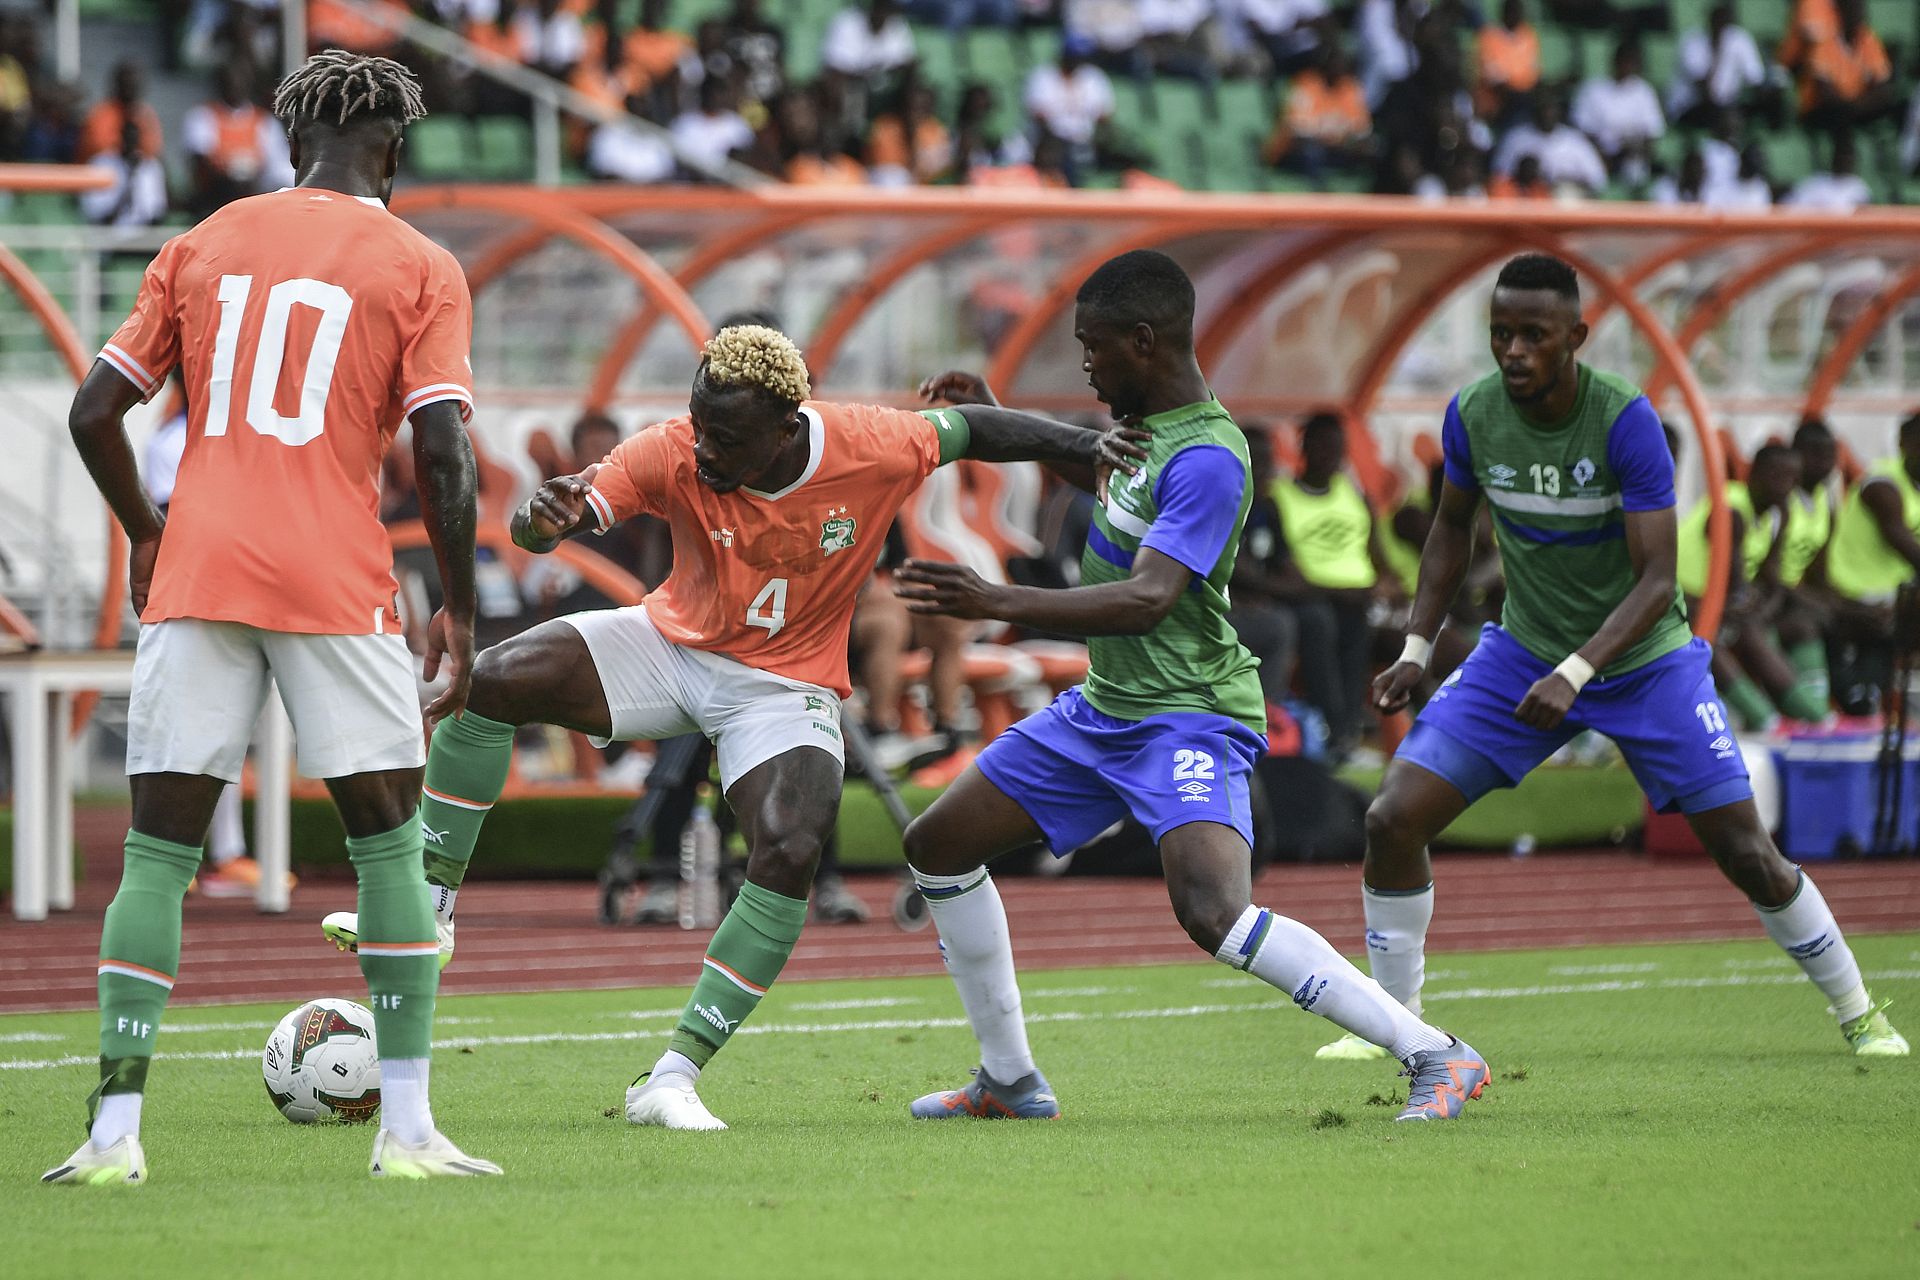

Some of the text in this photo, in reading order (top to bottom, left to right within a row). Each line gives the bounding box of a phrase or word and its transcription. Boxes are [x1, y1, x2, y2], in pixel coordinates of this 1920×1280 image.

[204, 274, 354, 447] 10
[1529, 463, 1561, 497] 13
[746, 577, 787, 639] 4
[1695, 701, 1726, 734] 13
[1173, 749, 1215, 781] 22
[1181, 794, 1210, 803] umbro
[371, 994, 403, 1010] FIF
[693, 1003, 724, 1031] PUMA
[117, 1016, 152, 1039] FIF
